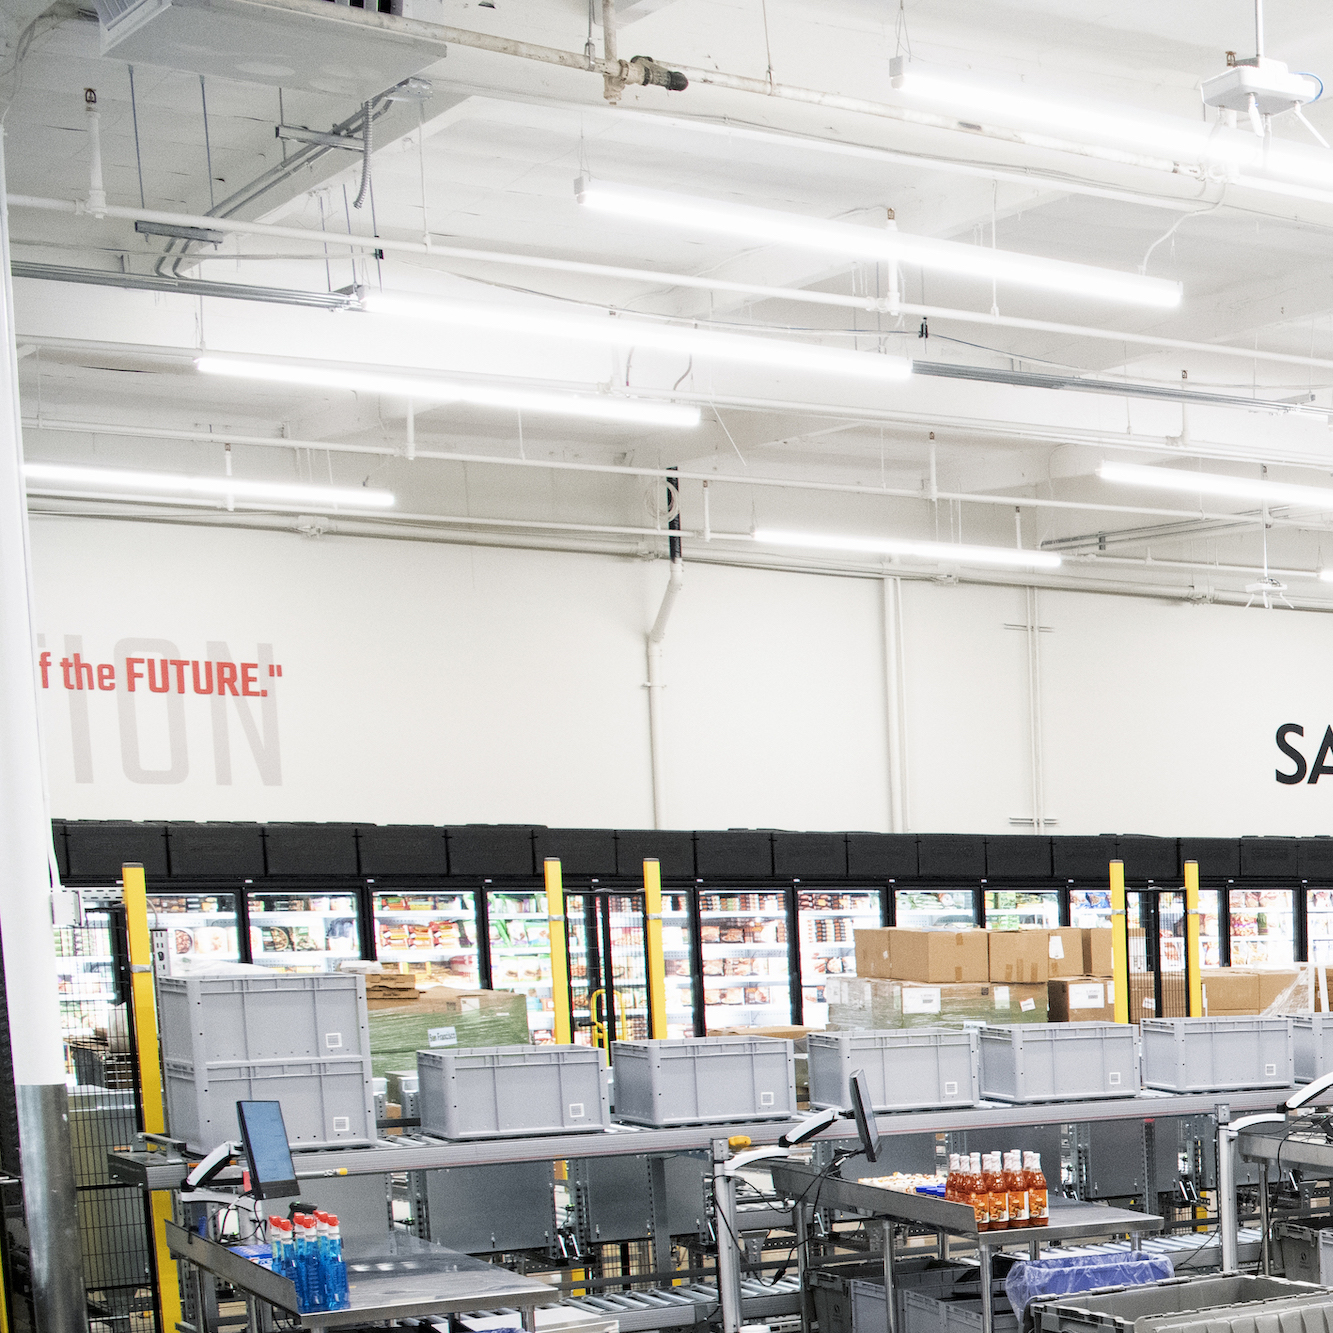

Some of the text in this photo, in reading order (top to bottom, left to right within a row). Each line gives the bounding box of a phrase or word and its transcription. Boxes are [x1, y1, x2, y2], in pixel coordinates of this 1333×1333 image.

[37, 633, 283, 786] ION
[39, 651, 283, 697] f the FUTURE."
